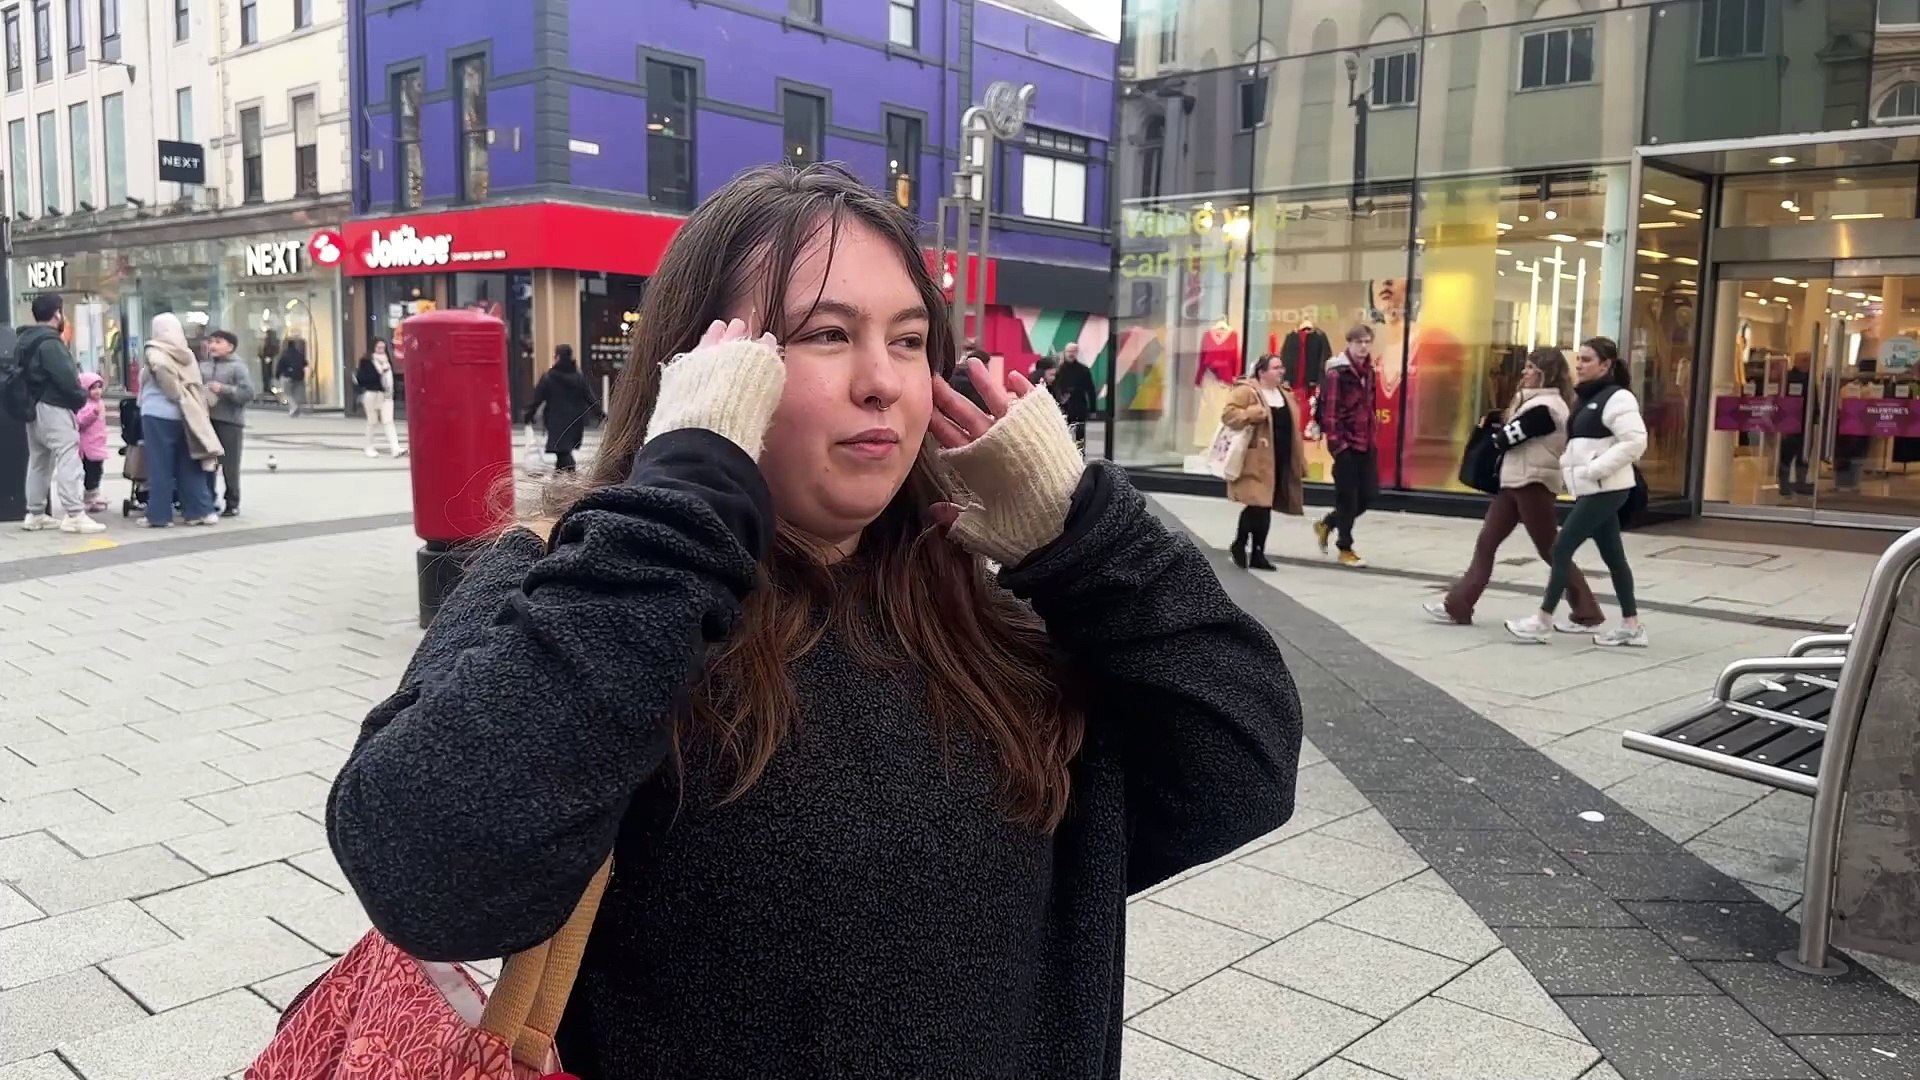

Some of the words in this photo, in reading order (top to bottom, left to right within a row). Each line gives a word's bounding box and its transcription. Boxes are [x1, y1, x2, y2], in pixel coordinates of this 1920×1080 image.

[162, 155, 200, 168] NEXT
[246, 241, 300, 276] NEXT
[365, 224, 449, 269] Jollibee
[28, 260, 65, 288] NEXT
[1119, 251, 1176, 279] can
[1503, 420, 1527, 445] H
